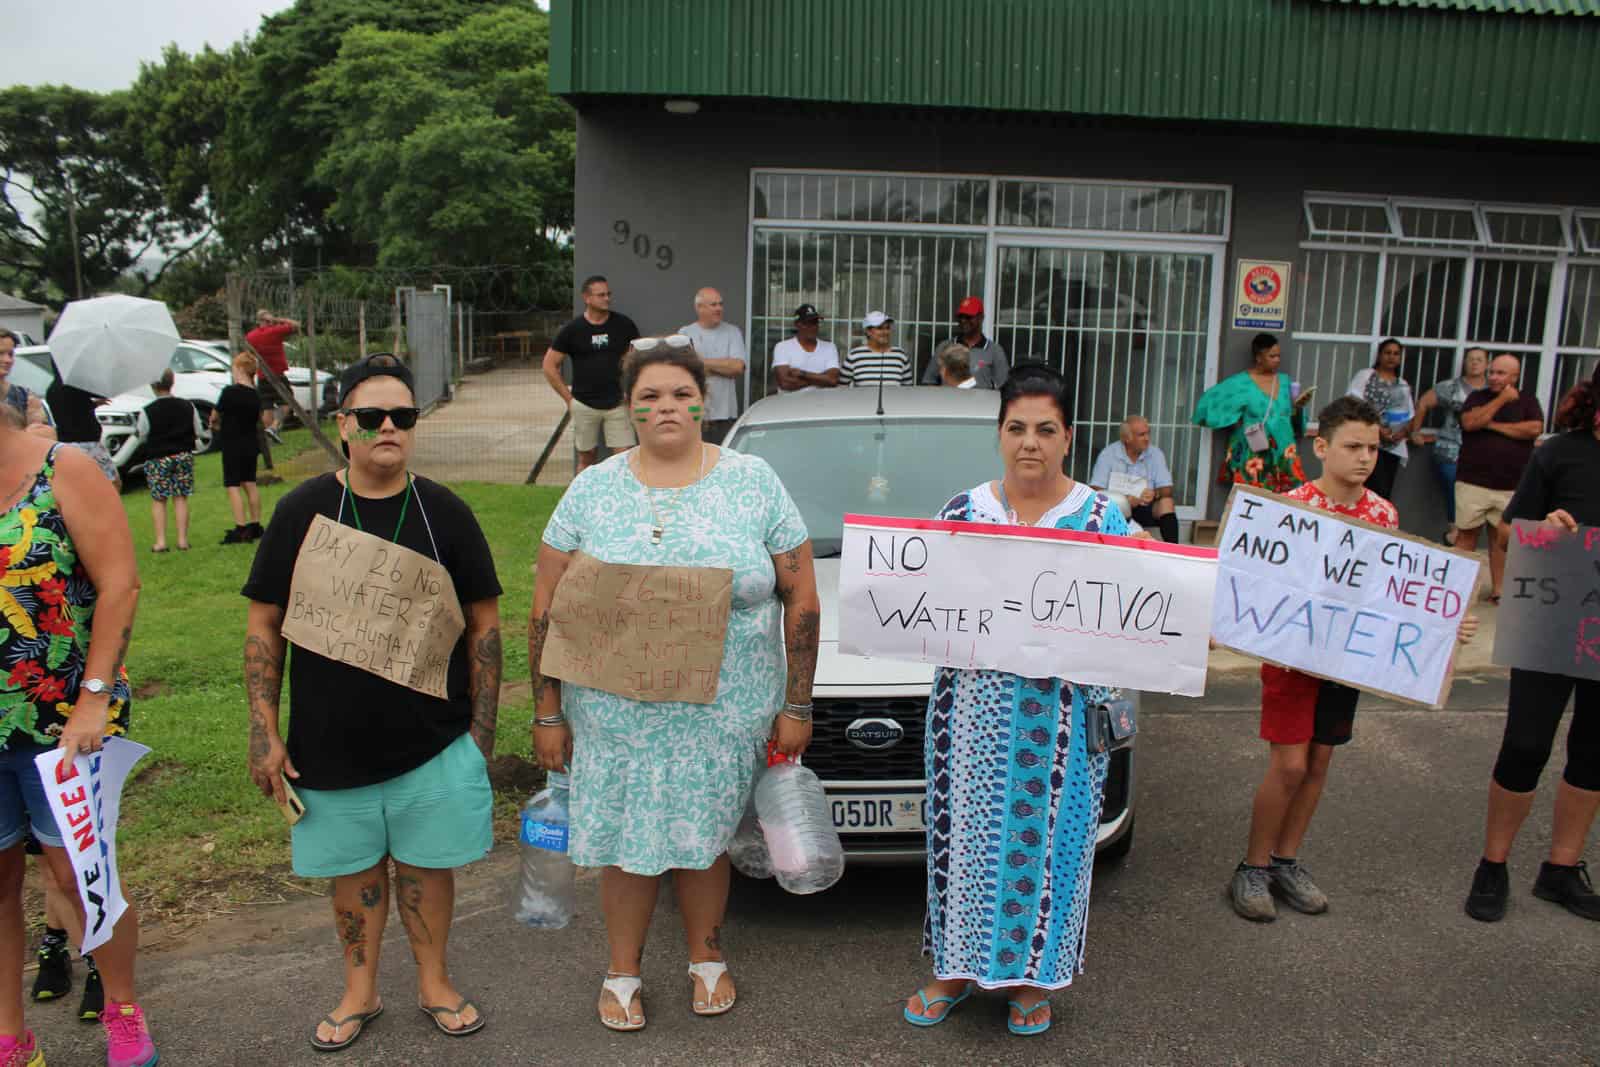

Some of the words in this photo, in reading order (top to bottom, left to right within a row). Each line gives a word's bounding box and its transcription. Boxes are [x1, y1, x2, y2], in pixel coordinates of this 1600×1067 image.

[613, 219, 673, 270] 909
[308, 523, 359, 569] DAY
[369, 549, 403, 584] 26
[868, 535, 929, 571] NO
[1237, 498, 1263, 521] I
[1278, 513, 1320, 542] AM
[1340, 529, 1355, 549] A
[1381, 542, 1450, 586] Child
[331, 576, 409, 625] WATER
[867, 590, 994, 635] WATER
[1031, 570, 1183, 637] GATVOL
[1231, 532, 1290, 565] AND
[1323, 555, 1369, 588] WE
[1386, 575, 1461, 618] NEED
[1512, 576, 1561, 605] IS
[289, 592, 342, 633] BASIC
[355, 619, 423, 657] HUMAN
[597, 605, 684, 634] WATER
[1230, 575, 1420, 678] WATER
[851, 729, 898, 739] DATSUN
[55, 756, 96, 853] NEED
[84, 862, 107, 937] WE
